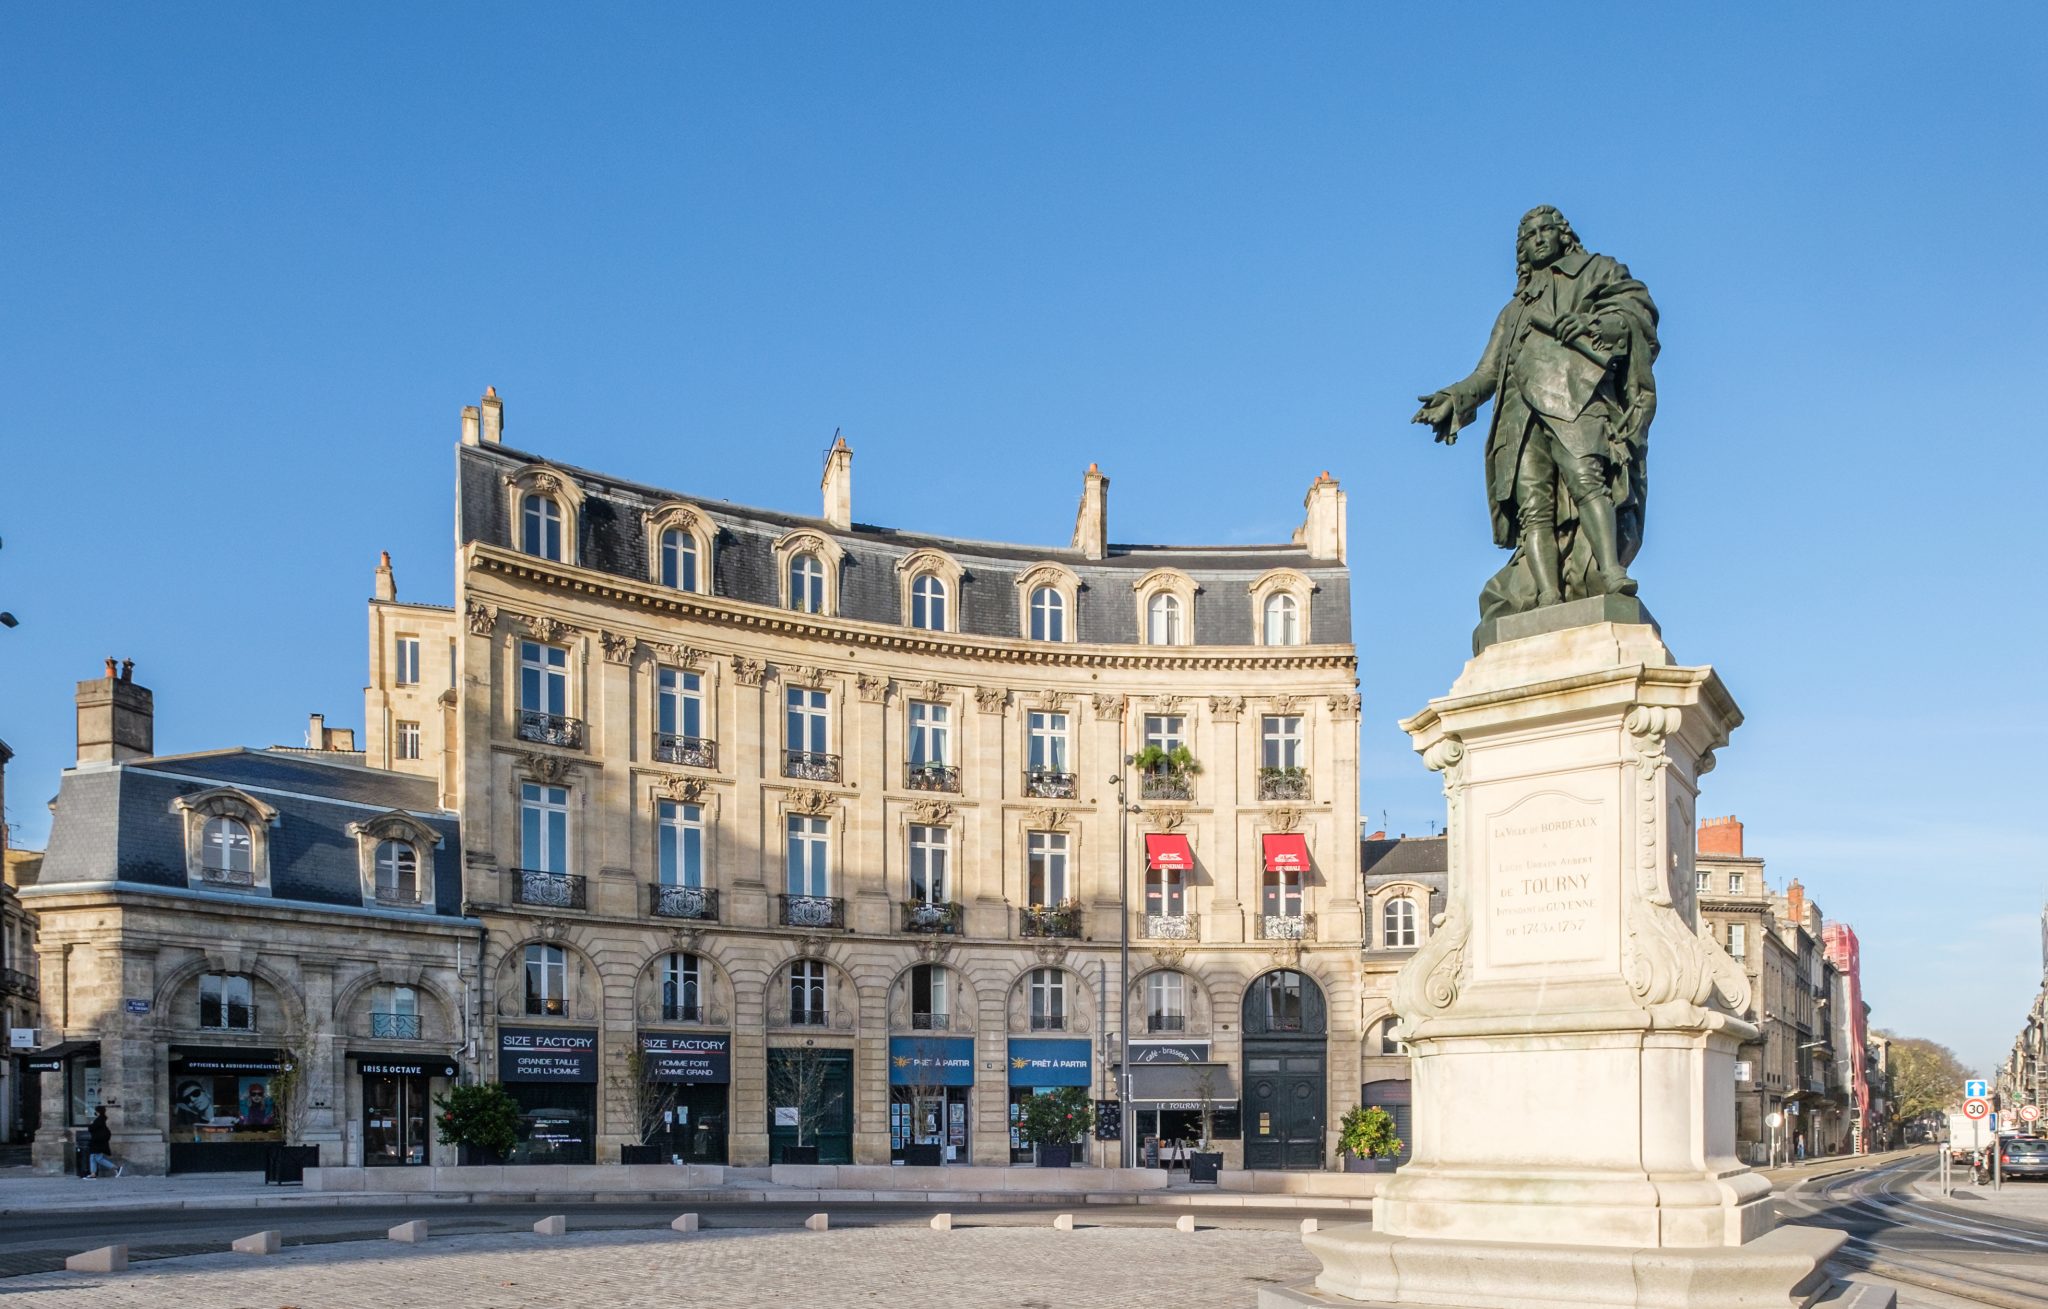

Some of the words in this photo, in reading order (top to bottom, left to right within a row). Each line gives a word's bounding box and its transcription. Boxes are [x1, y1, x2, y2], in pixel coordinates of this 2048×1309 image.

[1541, 816, 1598, 833] BORDEAUX
[1500, 887, 1514, 898] DE
[1520, 872, 1591, 896] TOURNY
[1546, 898, 1596, 913] GUYENNE
[503, 1035, 531, 1046] SIZE
[536, 1036, 593, 1048] FACTORY
[642, 1039, 668, 1048] SIZE
[672, 1040, 725, 1050] FACTORY
[1145, 1050, 1158, 1062] café
[1162, 1046, 1190, 1062] brasserie
[518, 1057, 552, 1065] GRANDE
[554, 1058, 580, 1066] TAILLE
[942, 1059, 970, 1067] PARTIR
[1031, 1059, 1051, 1068] PRÊT
[1053, 1059, 1059, 1068] À
[1060, 1060, 1087, 1068] PARTIR
[363, 1065, 381, 1073] IRIS
[382, 1065, 388, 1073] &
[389, 1066, 422, 1074] OCTAVE
[543, 1067, 581, 1075] L'HOMME
[1968, 1104, 1984, 1114] 30
